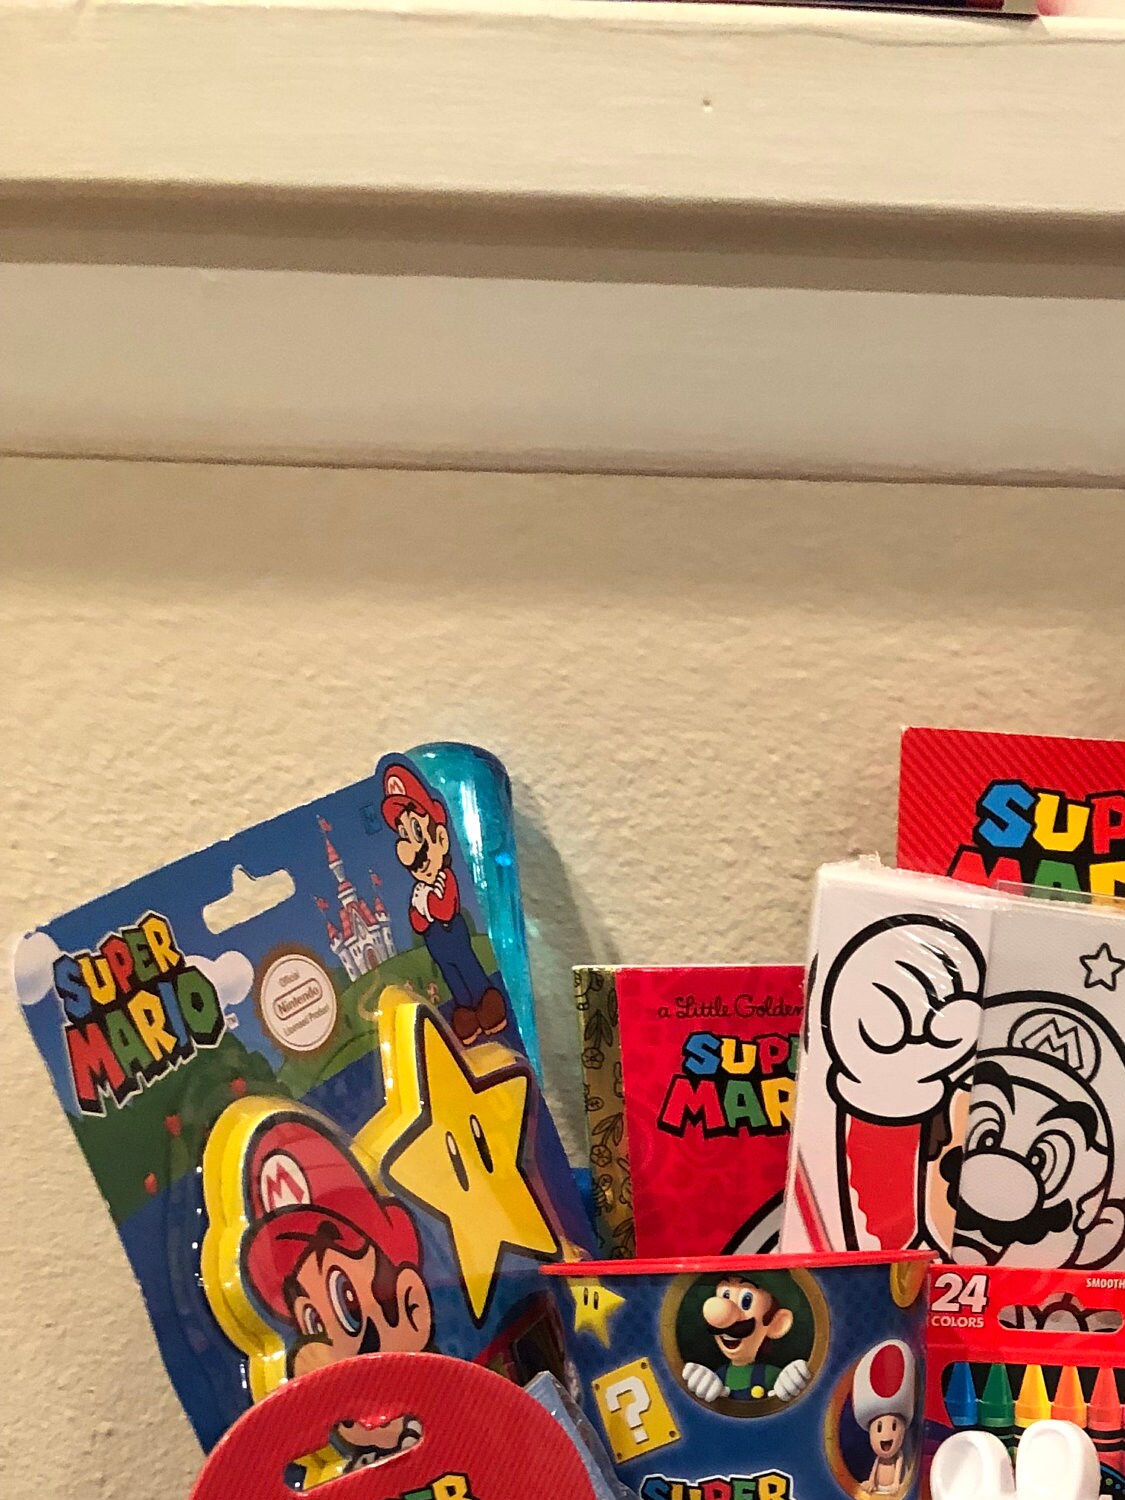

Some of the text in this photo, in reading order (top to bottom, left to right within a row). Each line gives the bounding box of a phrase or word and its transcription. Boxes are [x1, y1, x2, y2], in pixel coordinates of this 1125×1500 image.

[53, 913, 186, 1024] SUPER
[277, 986, 320, 1015] Nintendo
[658, 1005, 671, 1019] a
[675, 995, 731, 1019] Little
[65, 966, 225, 1114] MARIO
[682, 1031, 800, 1077] SUP
[657, 1073, 797, 1139] MAR
[931, 1272, 990, 1315] 24
[930, 1315, 985, 1329] COLORS
